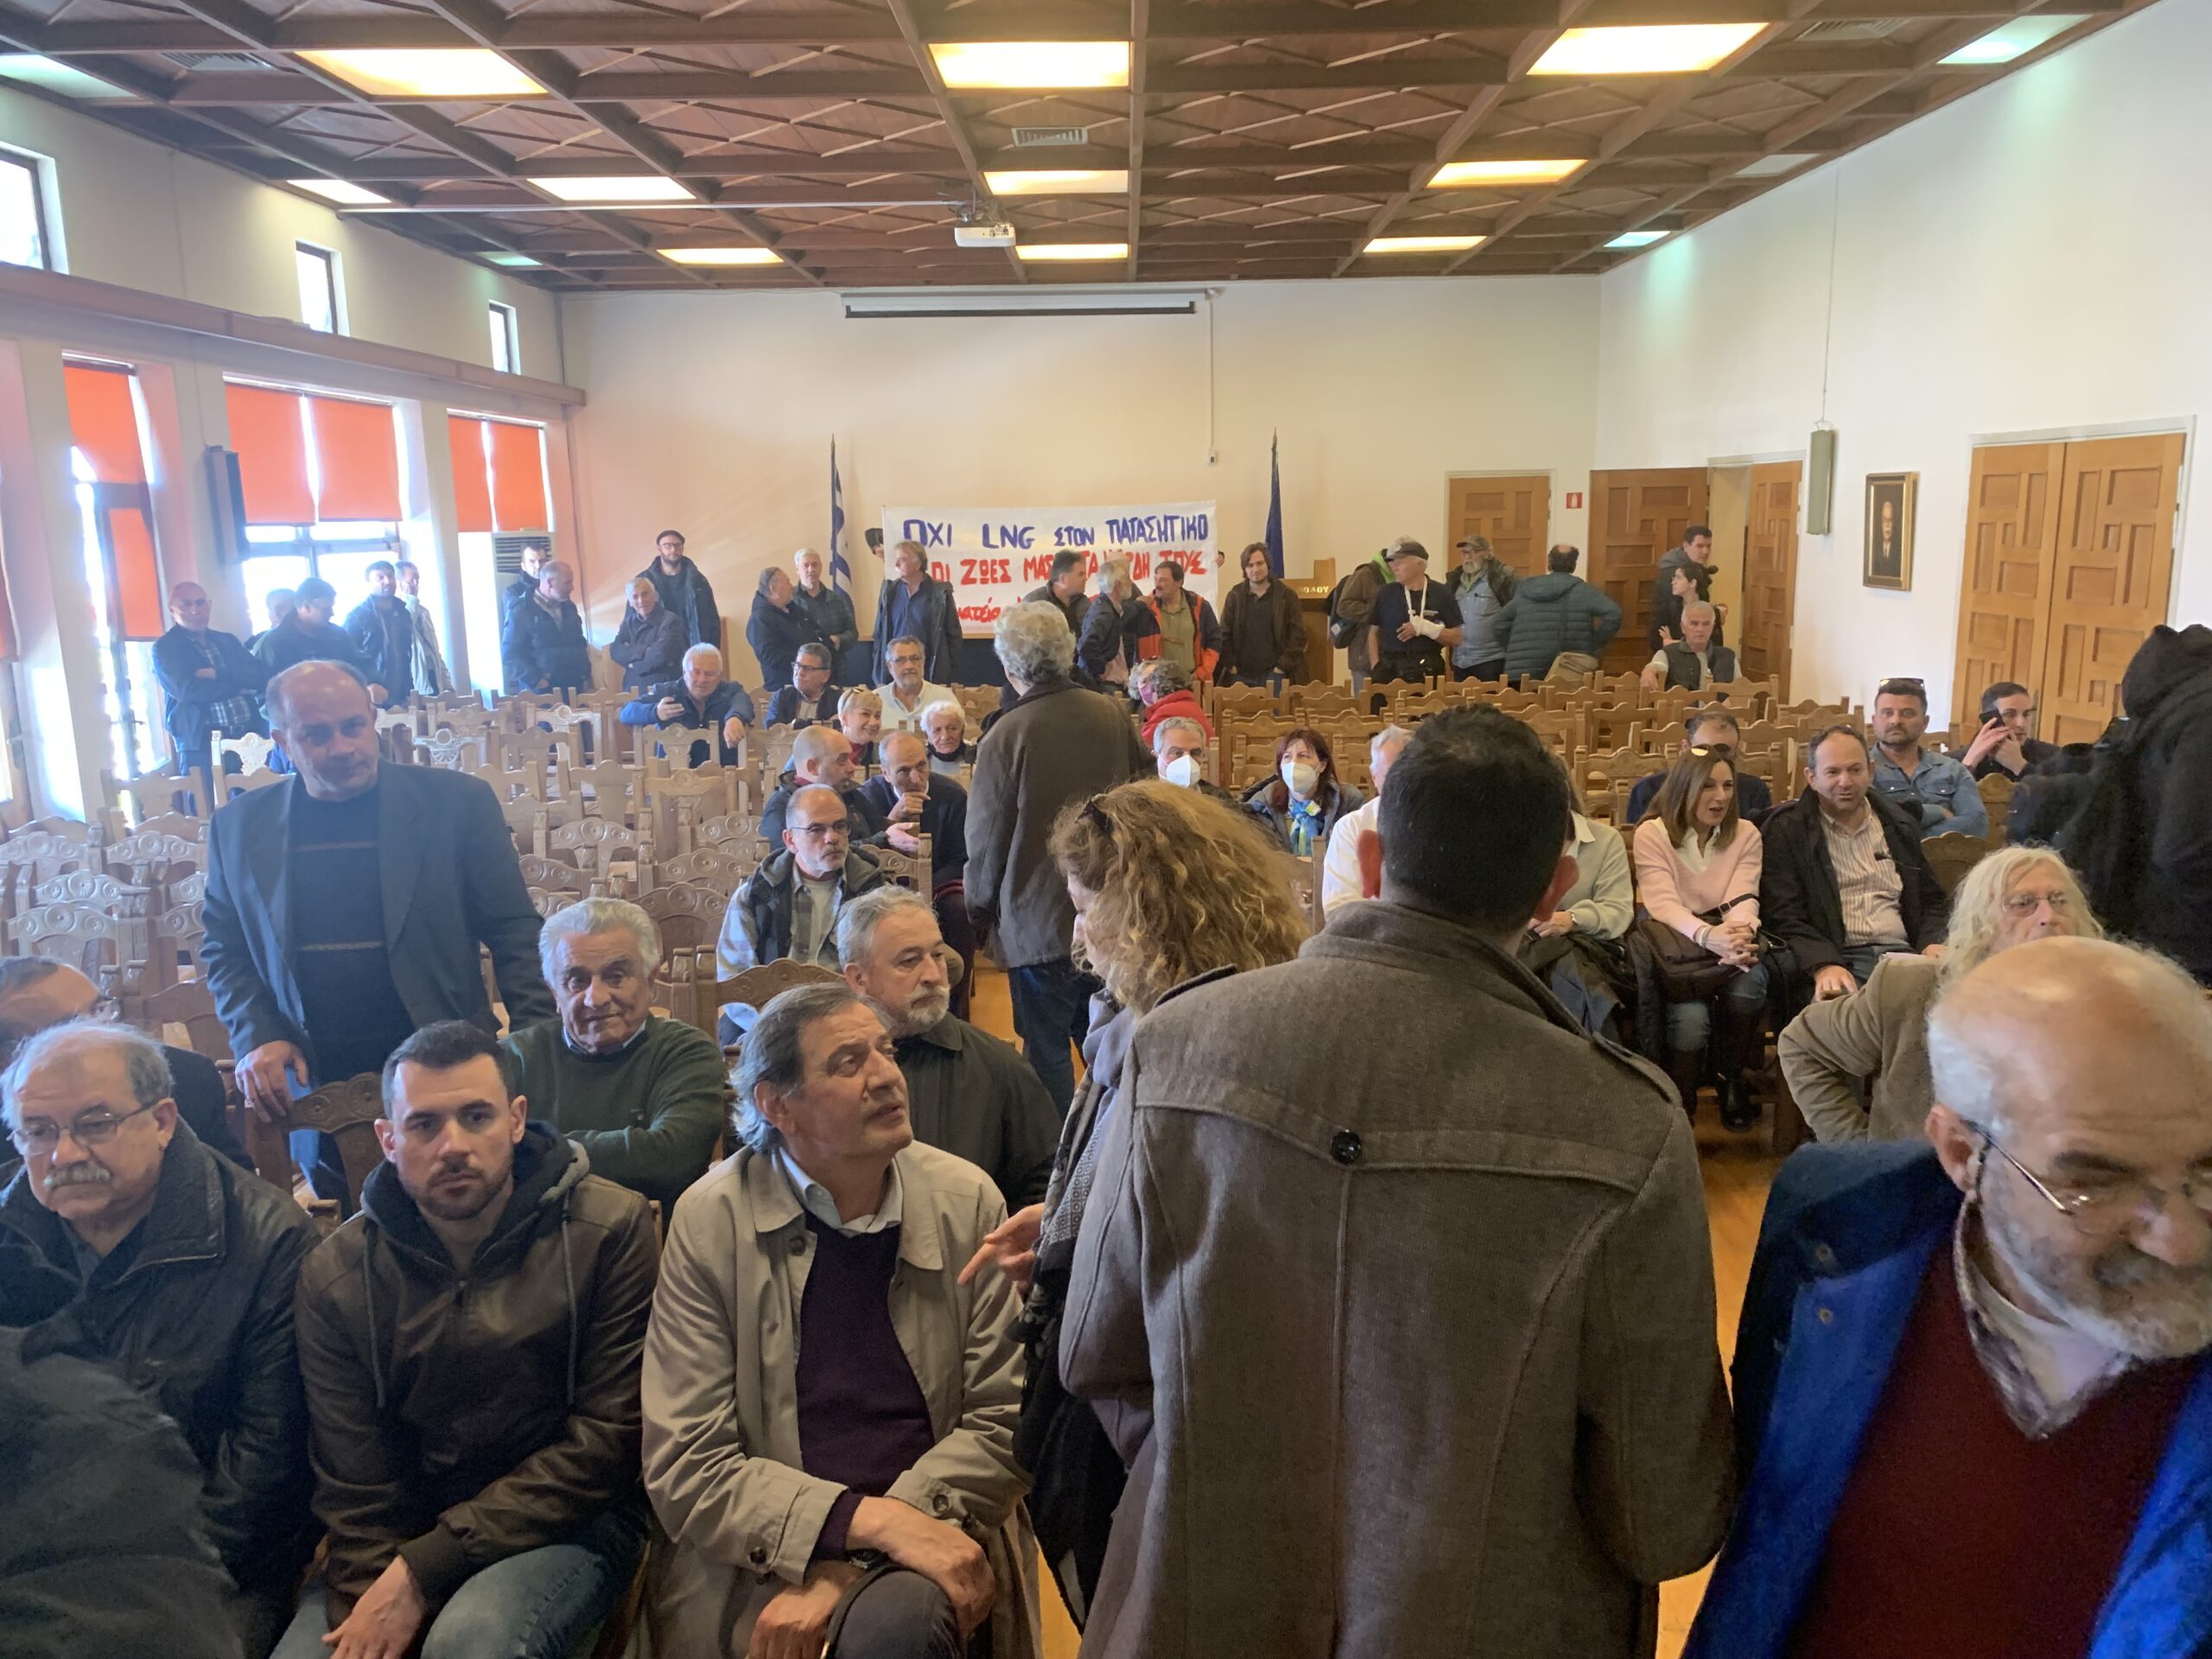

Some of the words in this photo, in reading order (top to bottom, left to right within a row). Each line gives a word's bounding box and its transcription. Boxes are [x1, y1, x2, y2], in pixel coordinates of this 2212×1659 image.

[903, 518, 952, 548] ΟΧΙ
[982, 523, 1035, 550] LNG
[1053, 525, 1095, 546] ΣΤΟΝ
[959, 558, 1012, 585] ΖΩΕΣ
